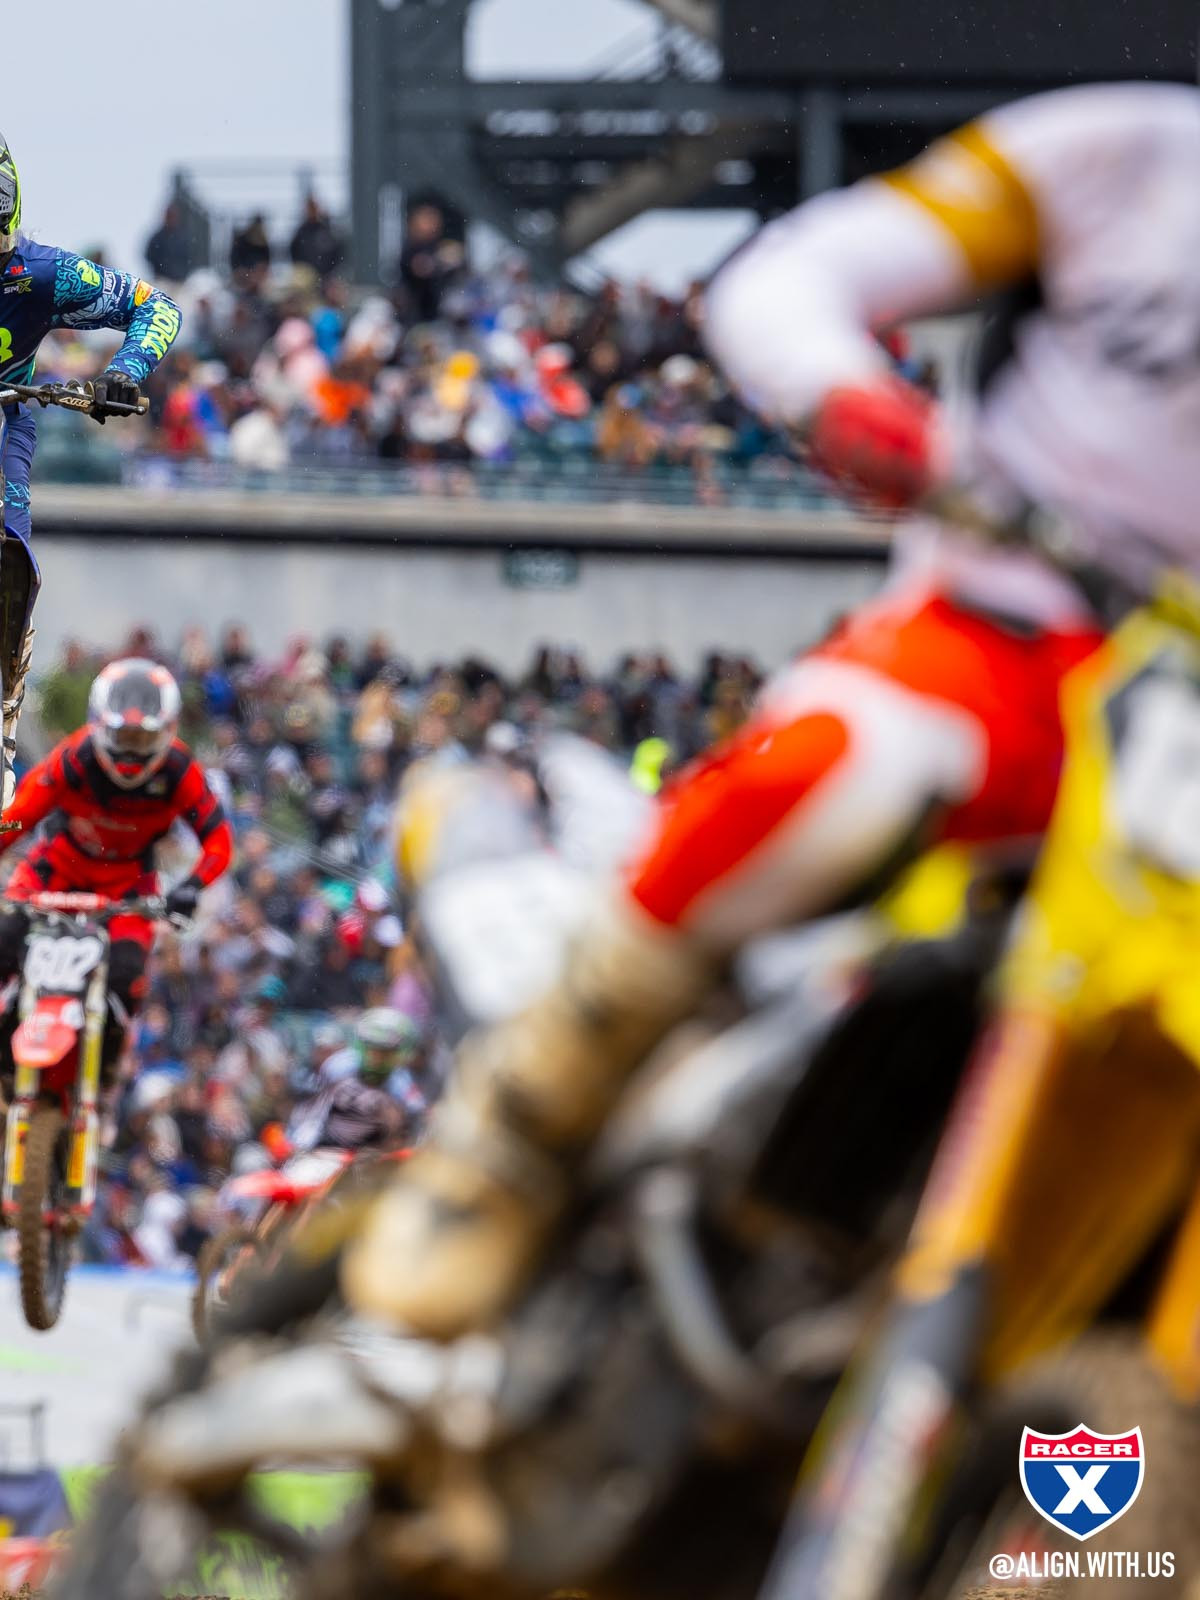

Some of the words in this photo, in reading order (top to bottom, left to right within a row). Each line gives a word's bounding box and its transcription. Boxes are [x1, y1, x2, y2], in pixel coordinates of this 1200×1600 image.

[3, 279, 32, 295] SMX
[141, 301, 180, 360] THOR
[58, 396, 91, 408] ARC
